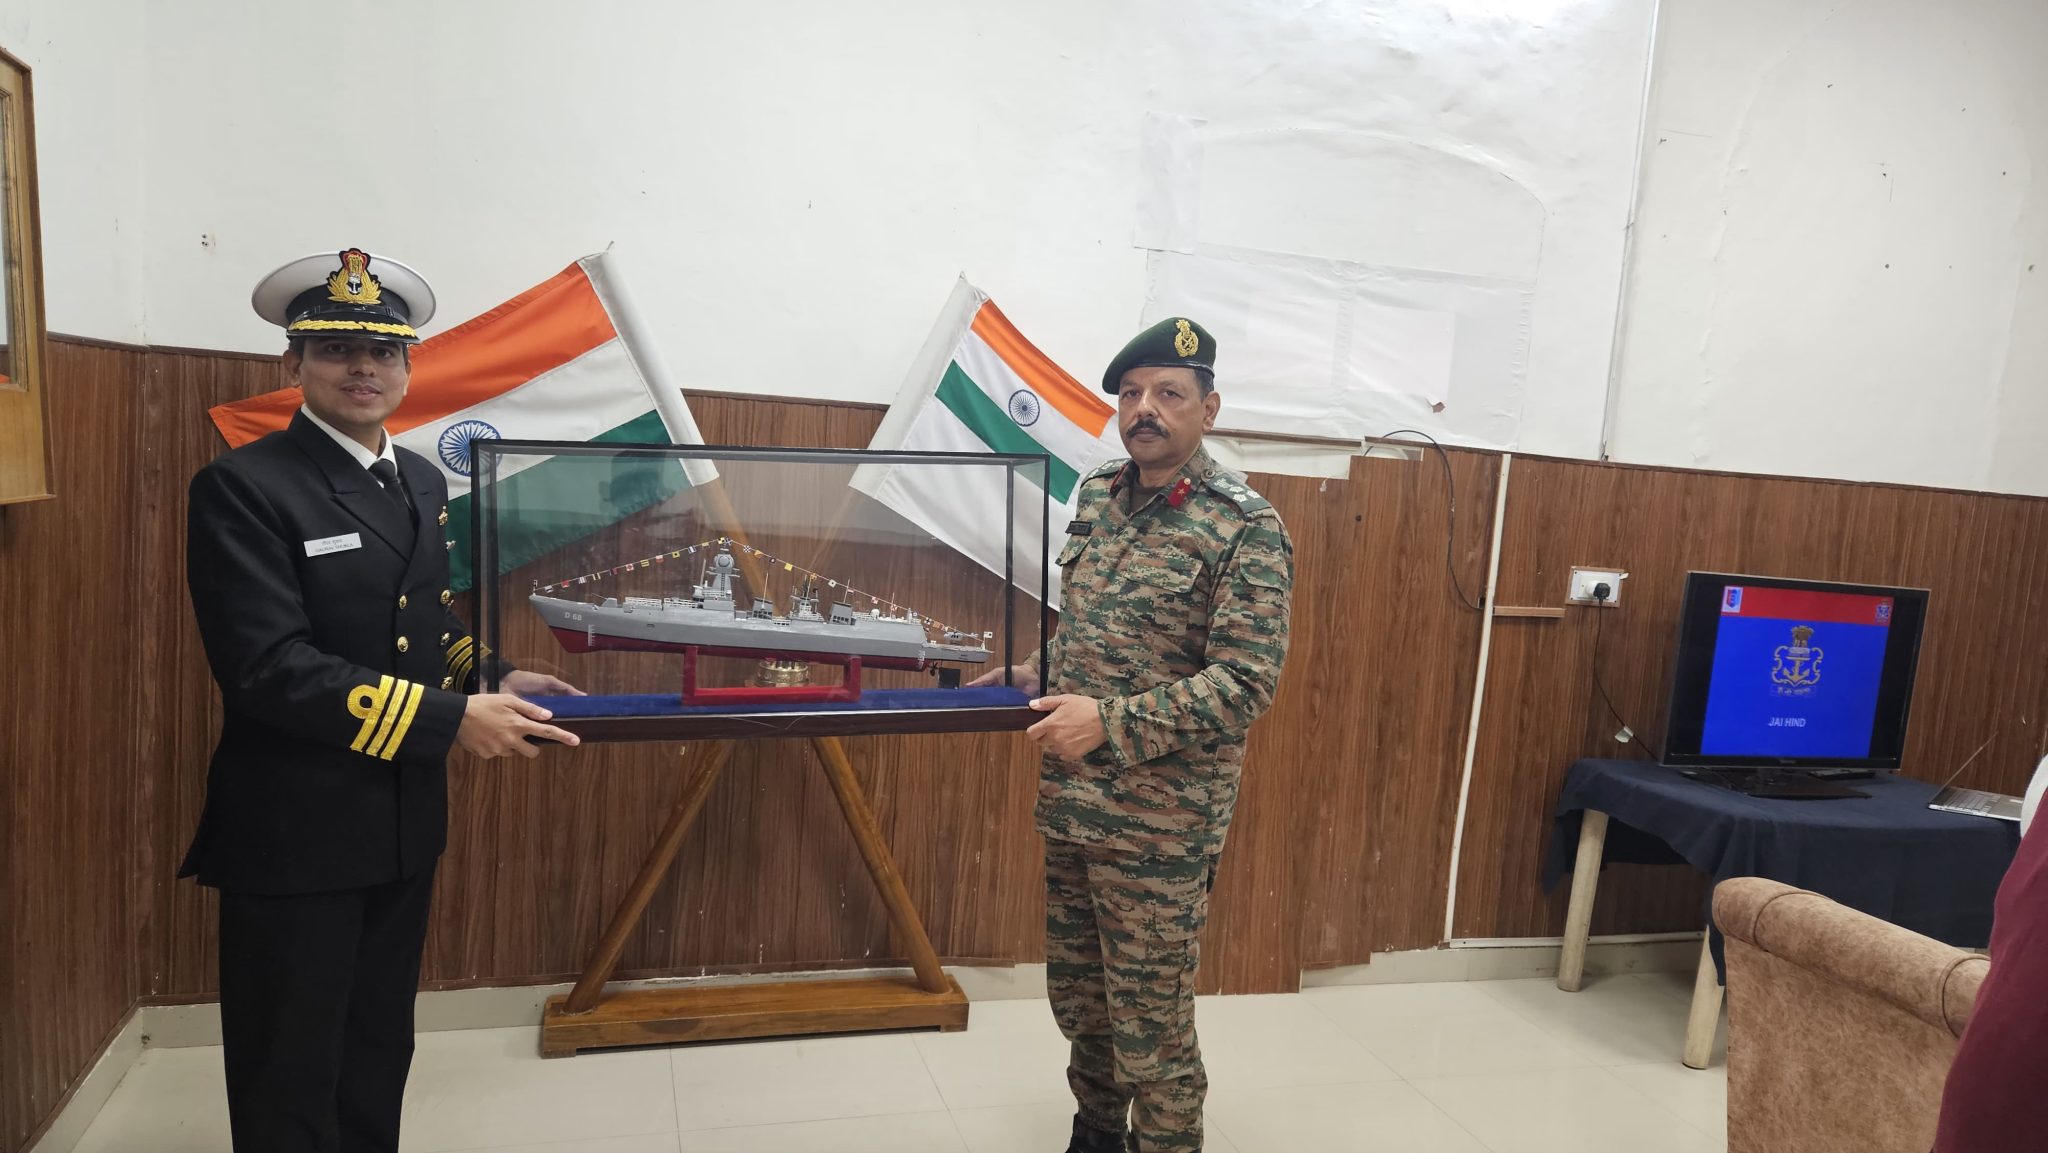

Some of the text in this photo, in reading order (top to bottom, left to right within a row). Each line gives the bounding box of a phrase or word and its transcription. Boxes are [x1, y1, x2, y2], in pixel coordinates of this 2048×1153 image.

[564, 611, 571, 619] D
[1768, 717, 1806, 727] JAI HIND
